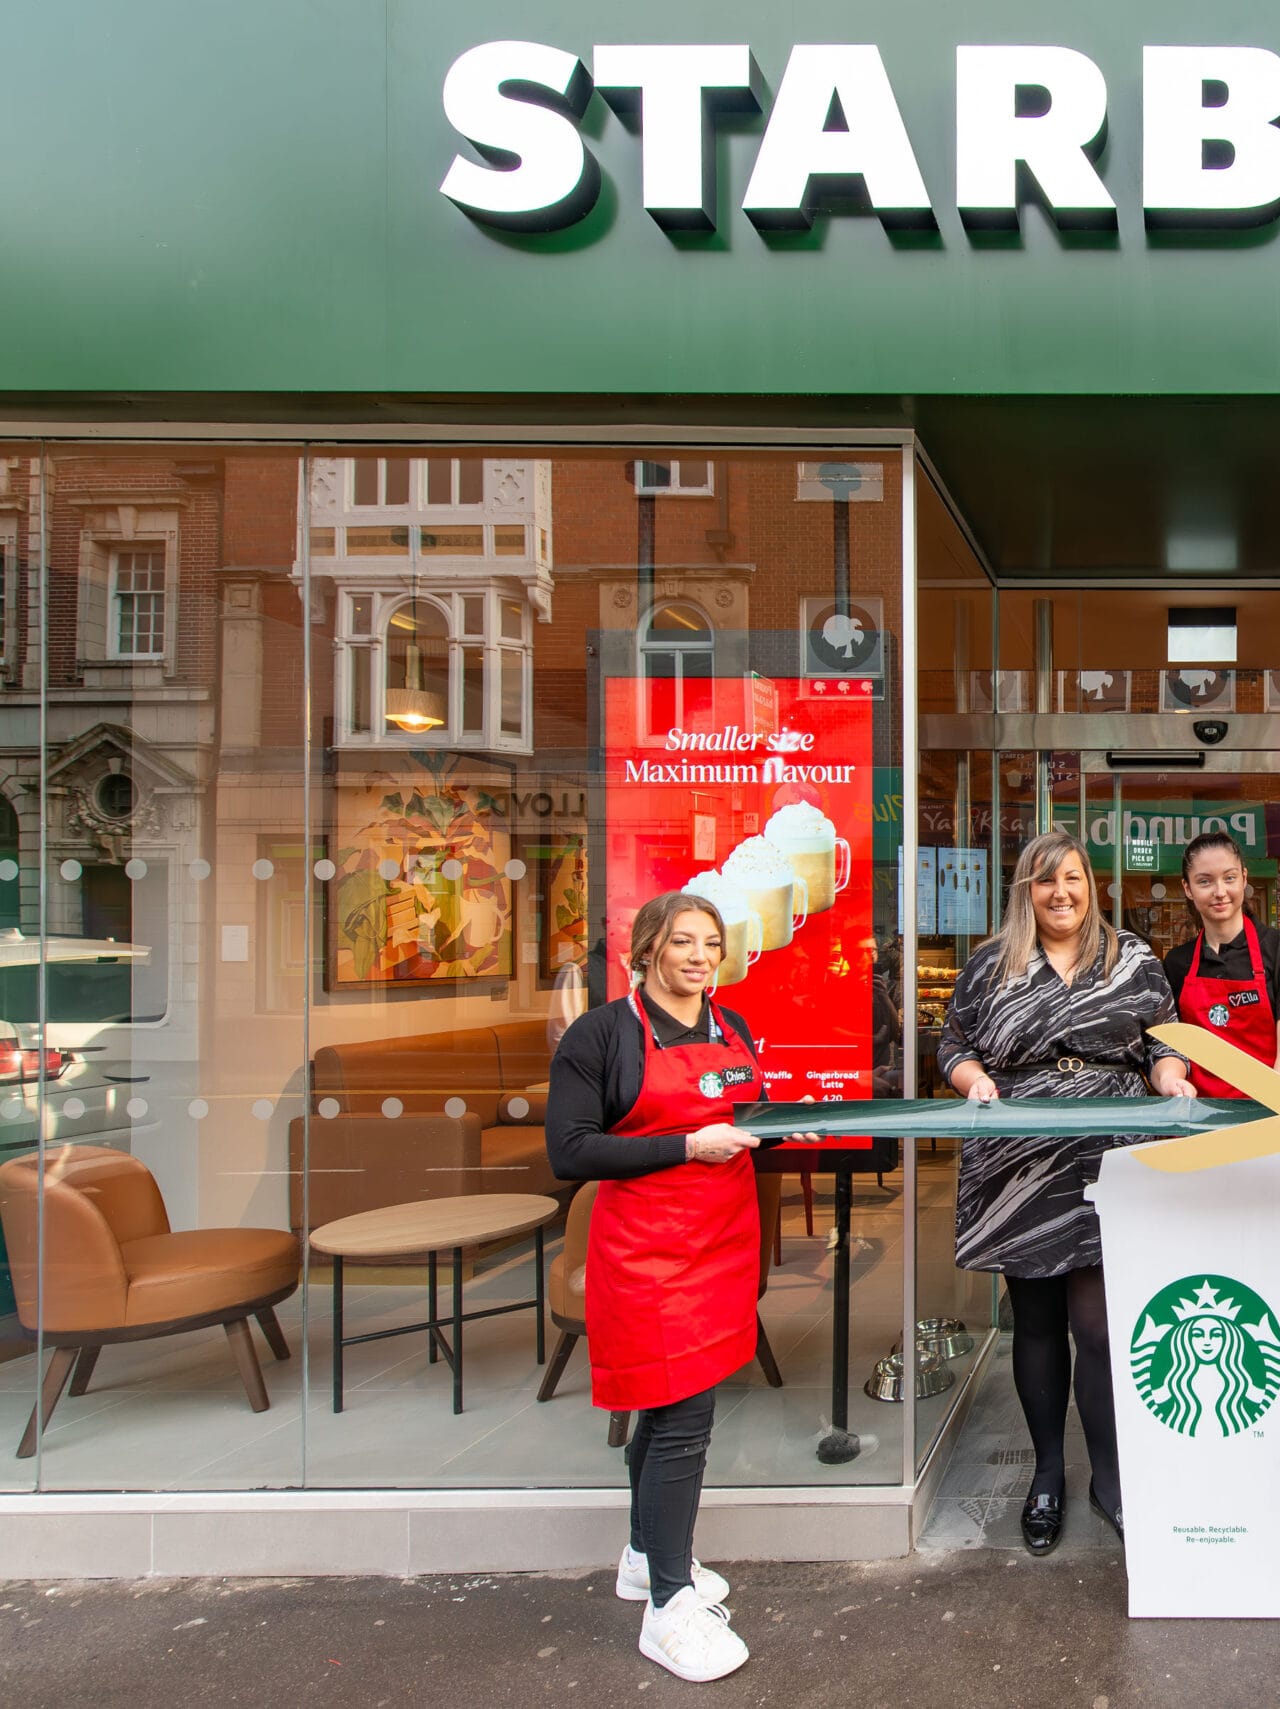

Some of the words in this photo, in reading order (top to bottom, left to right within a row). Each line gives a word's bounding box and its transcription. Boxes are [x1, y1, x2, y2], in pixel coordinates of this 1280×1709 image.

[665, 726, 763, 752] Smaller
[765, 727, 815, 752] size
[624, 759, 758, 784] Maximum
[762, 757, 855, 784] flavour
[1132, 839, 1153, 847] MOBILE
[1133, 847, 1153, 855] ORDER
[1131, 854, 1145, 862] PICK
[1240, 992, 1259, 1004] Ella
[725, 1070, 747, 1083] Chloe
[763, 1070, 793, 1080] Waffle
[806, 1070, 859, 1082] Gingerbread
[820, 1081, 845, 1089] Latte
[1172, 1525, 1207, 1534] Reusable.
[1208, 1525, 1249, 1535] Recyclable.
[1185, 1535, 1237, 1545] Re-enjoyable.
